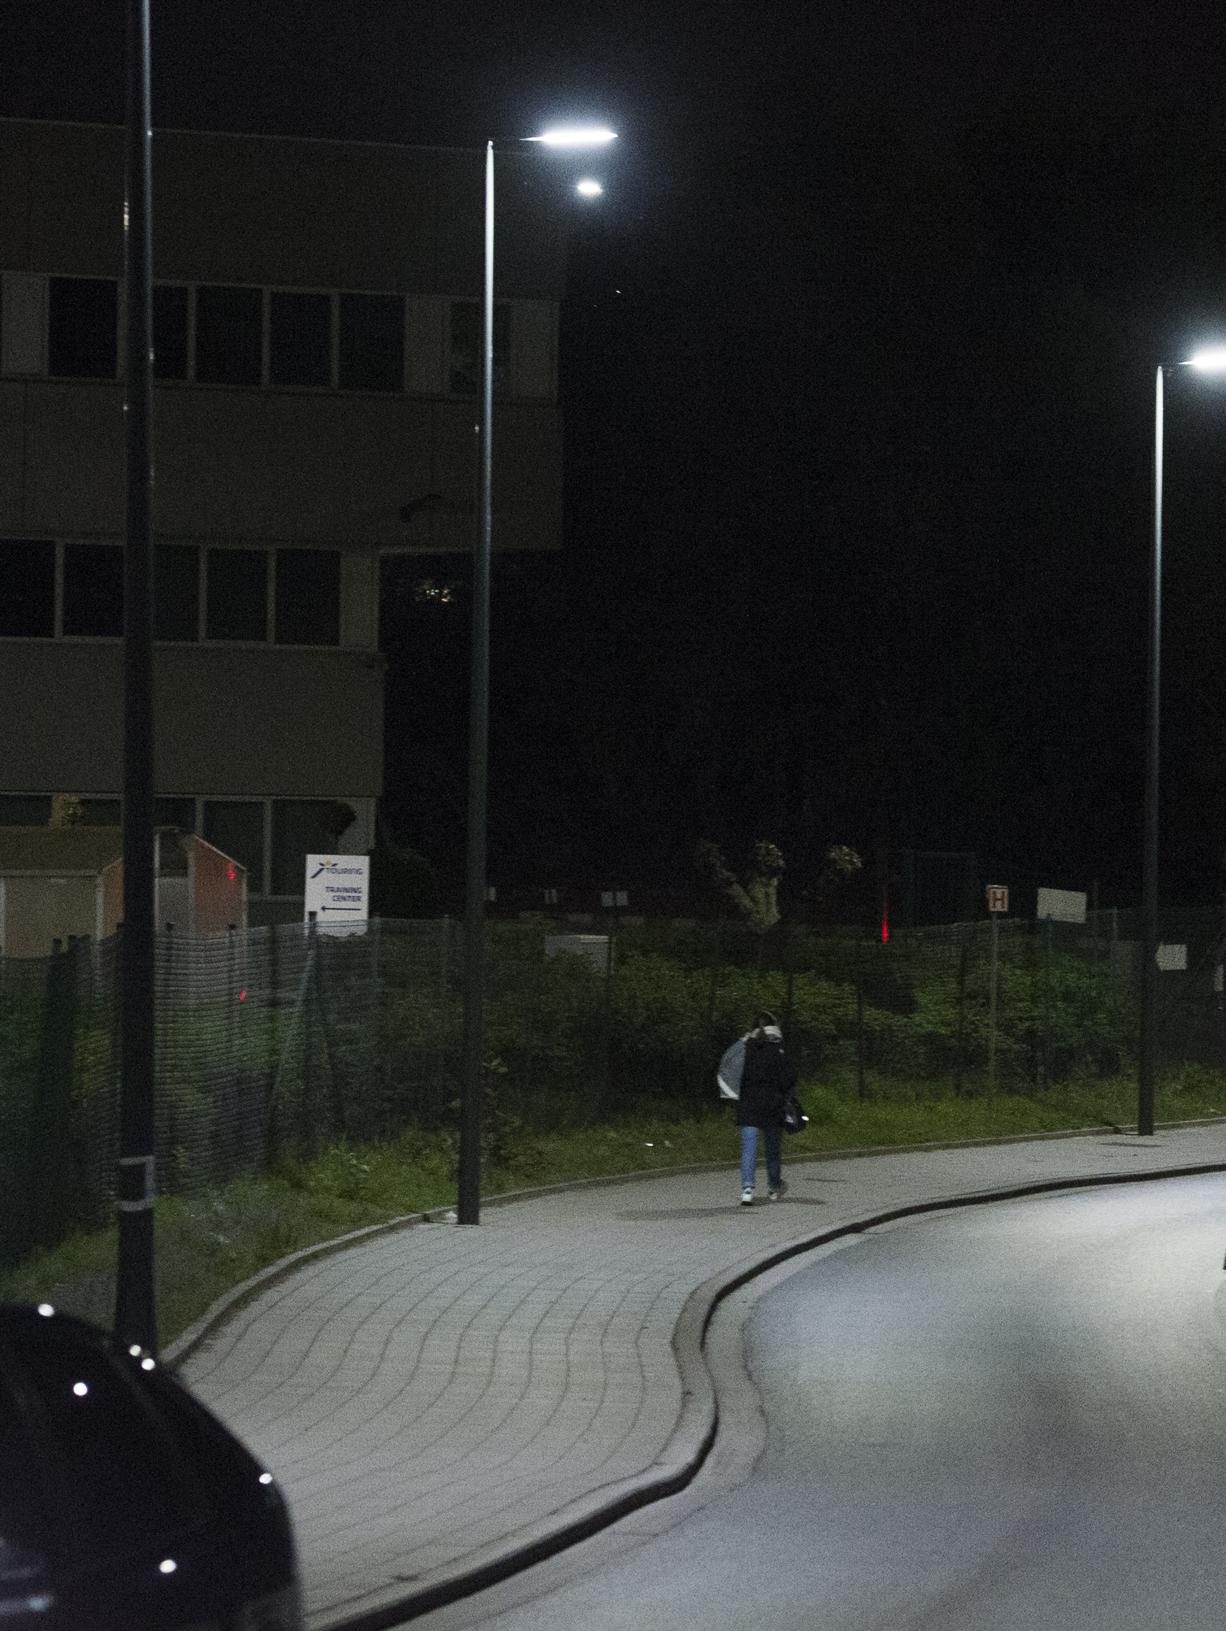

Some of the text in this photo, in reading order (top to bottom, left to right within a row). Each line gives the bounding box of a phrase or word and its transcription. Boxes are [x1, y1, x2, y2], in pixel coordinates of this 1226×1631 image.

[326, 867, 363, 875] TOURING
[325, 886, 362, 894] TRAINING
[992, 890, 1006, 909] H
